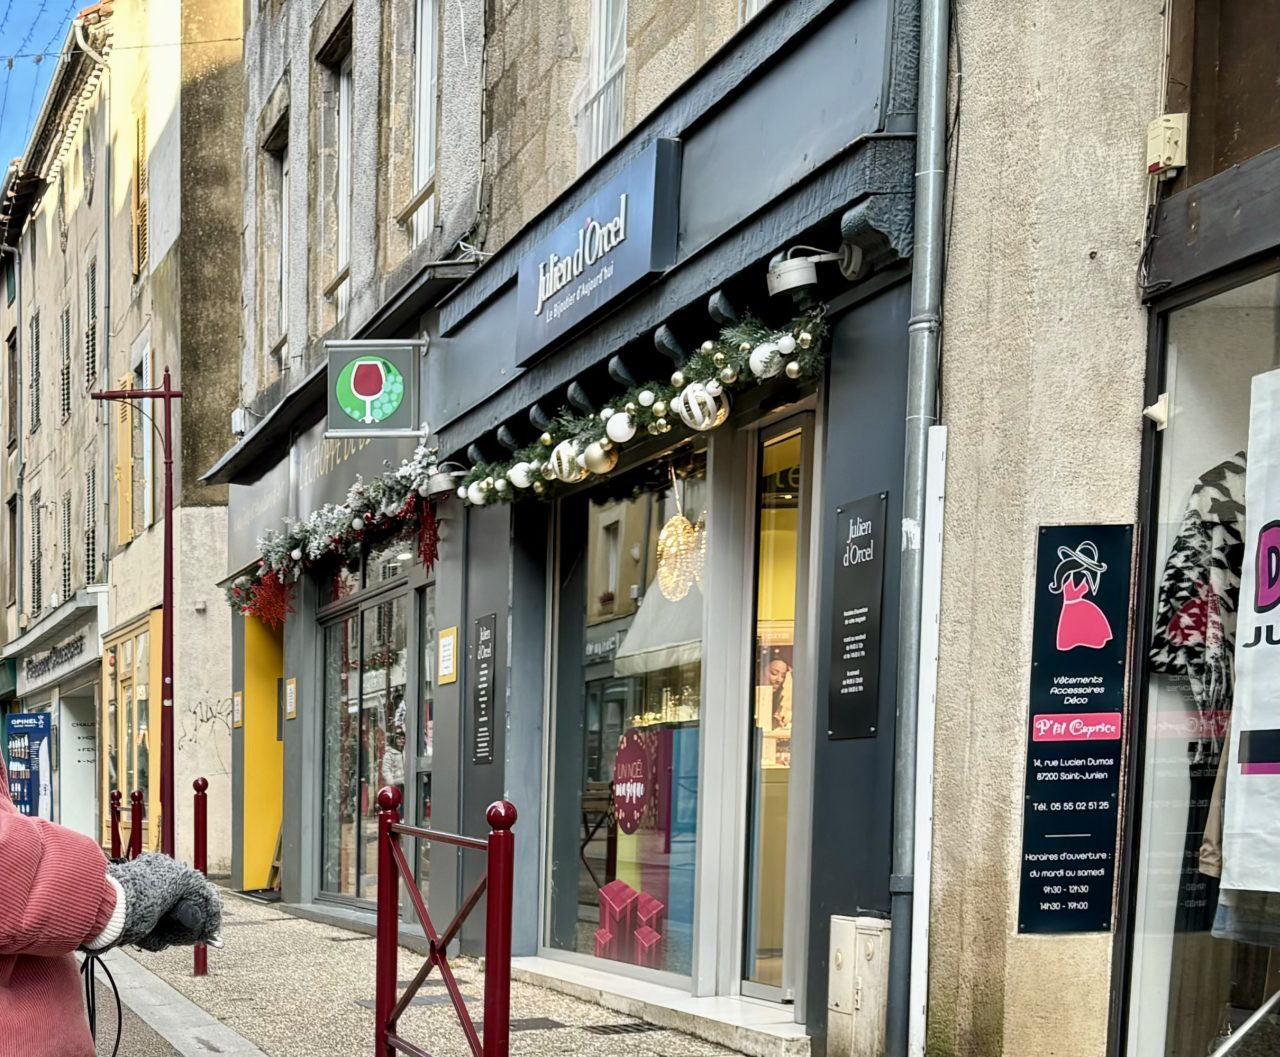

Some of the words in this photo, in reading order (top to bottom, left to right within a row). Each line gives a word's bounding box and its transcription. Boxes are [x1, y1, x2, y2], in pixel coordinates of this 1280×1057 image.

[534, 253, 574, 317] Julien
[573, 193, 627, 277] d'Orcel
[846, 516, 872, 544] Julien
[843, 539, 874, 567] d'Orcel
[1053, 676, 1103, 685] Vêtements
[1050, 686, 1105, 694] Accessoires
[1063, 696, 1089, 704] Déco
[1035, 719, 1066, 736] P'tit
[1069, 719, 1116, 738] Caprice
[1033, 759, 1042, 768] 14,
[1044, 759, 1059, 767] rue
[1060, 758, 1086, 767] Lucien
[1087, 757, 1114, 766] Dumas
[1037, 772, 1058, 780] 87200
[1060, 771, 1108, 780] Saint-Junien
[1033, 802, 1048, 811] Tél.
[1050, 802, 1061, 811] 05
[1063, 802, 1074, 810] 55
[1075, 802, 1086, 810] 02
[1088, 801, 1097, 810] 51
[1098, 801, 1110, 810] 25
[1025, 852, 1058, 861] Horaires
[1060, 851, 1107, 861] d'ouverture
[1029, 869, 1040, 878] du
[1041, 868, 1064, 877] mardi
[1065, 869, 1076, 877] au
[1077, 868, 1104, 876] samedi
[1043, 885, 1061, 893] 9h30
[1068, 885, 1089, 893] 12h30
[1040, 902, 1061, 910] 14h30
[1067, 901, 1088, 910] 19h00
